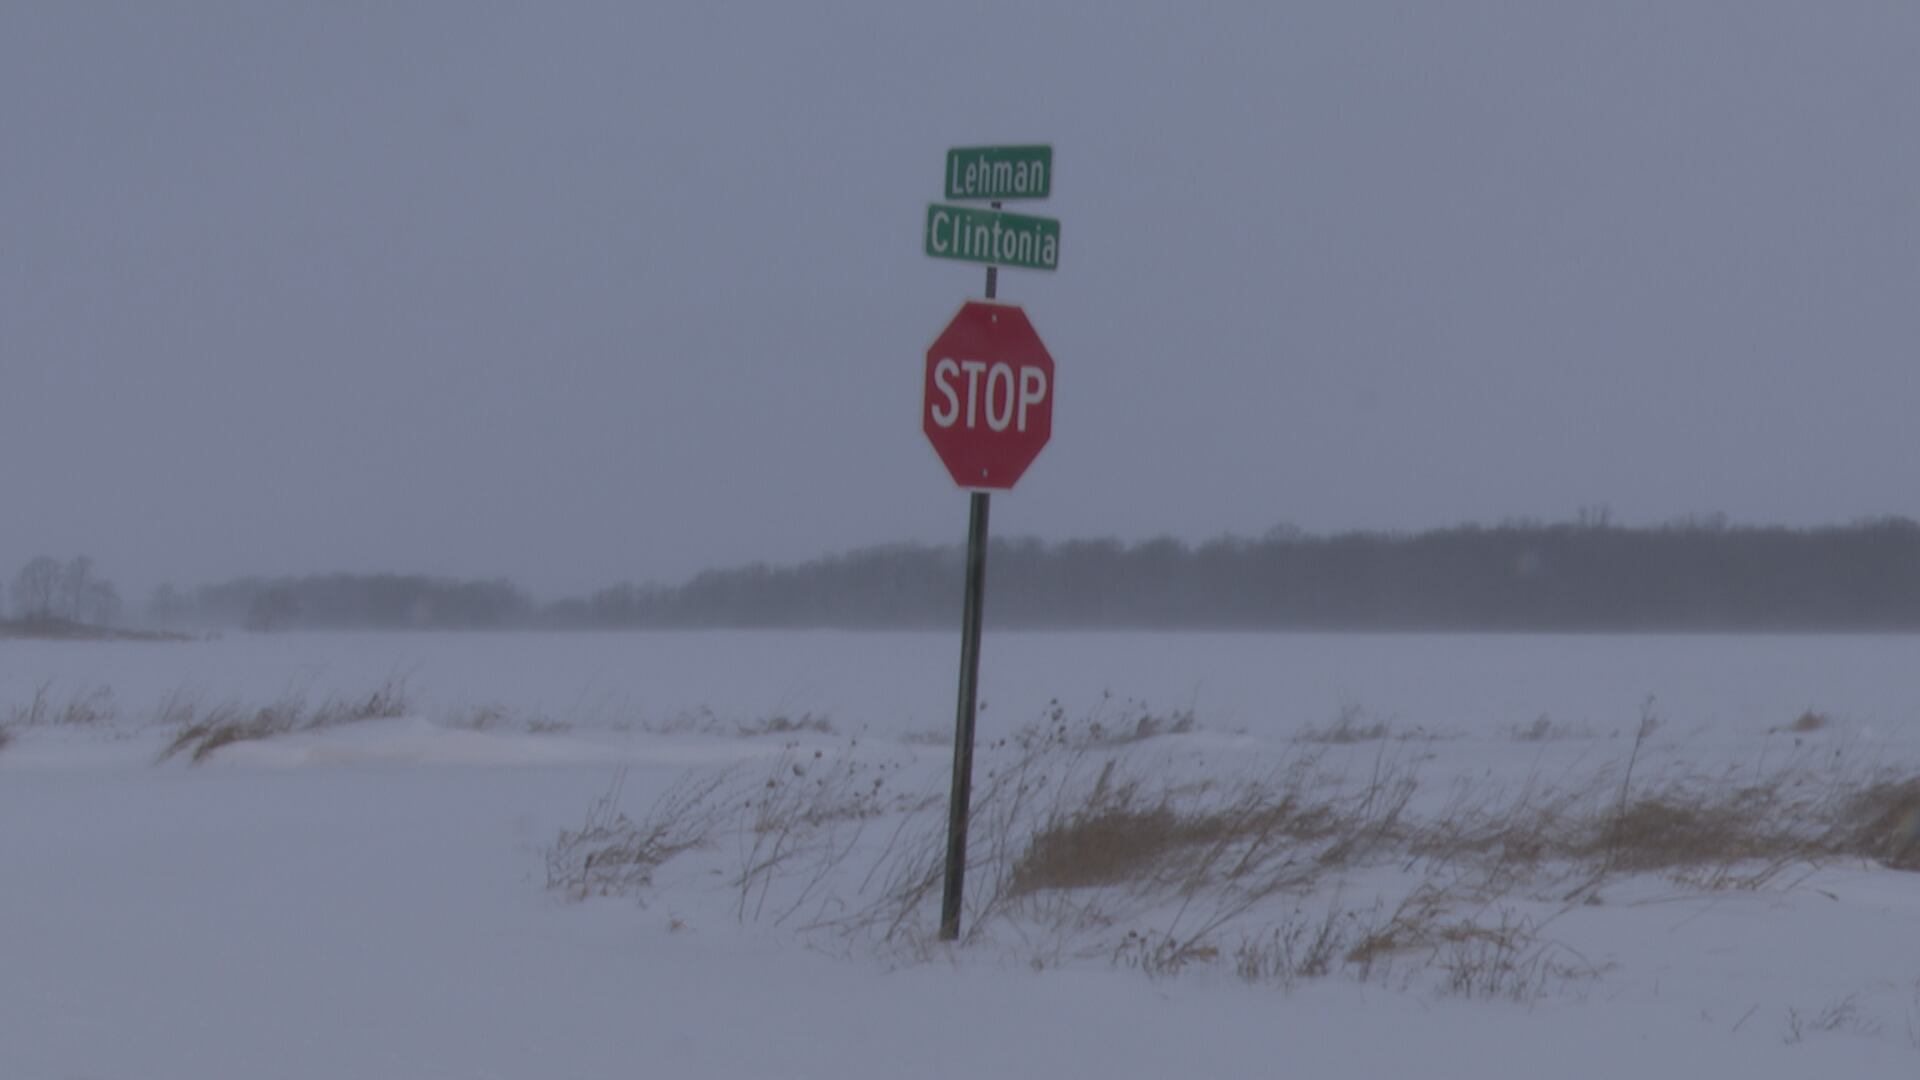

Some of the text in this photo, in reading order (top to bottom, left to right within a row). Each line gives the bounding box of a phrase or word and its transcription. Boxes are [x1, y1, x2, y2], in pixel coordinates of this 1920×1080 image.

[952, 154, 1044, 194] Lehman
[931, 210, 1056, 265] Clintonia
[932, 357, 1047, 432] STOP
